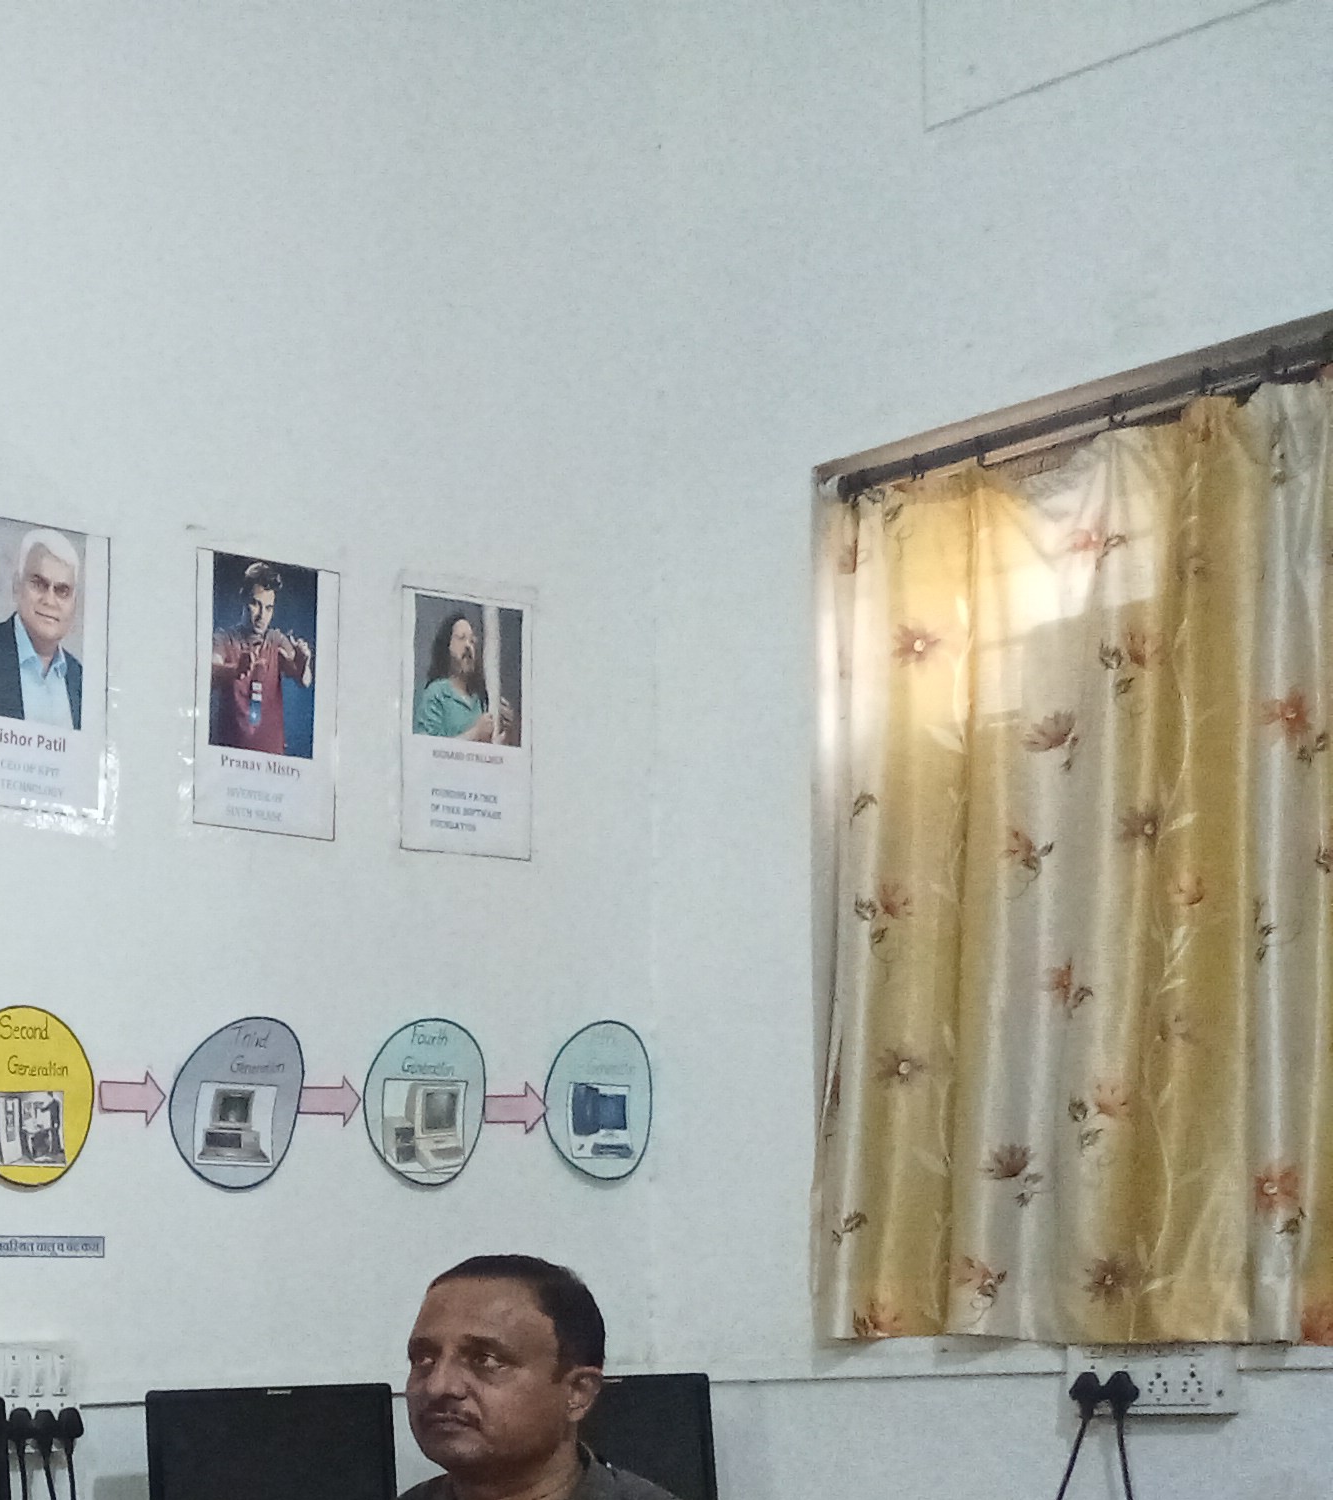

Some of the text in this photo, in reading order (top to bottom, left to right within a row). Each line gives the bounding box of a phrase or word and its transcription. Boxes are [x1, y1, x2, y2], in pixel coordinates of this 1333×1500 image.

[37, 734, 66, 753] Patil
[220, 753, 301, 779] Pranav Mistry
[0, 1014, 51, 1042] Second
[231, 1024, 270, 1050] Third
[410, 1024, 449, 1047] Fourth
[7, 1054, 69, 1078] Generation
[229, 1056, 286, 1075] Generation
[401, 1055, 456, 1077] Generation
